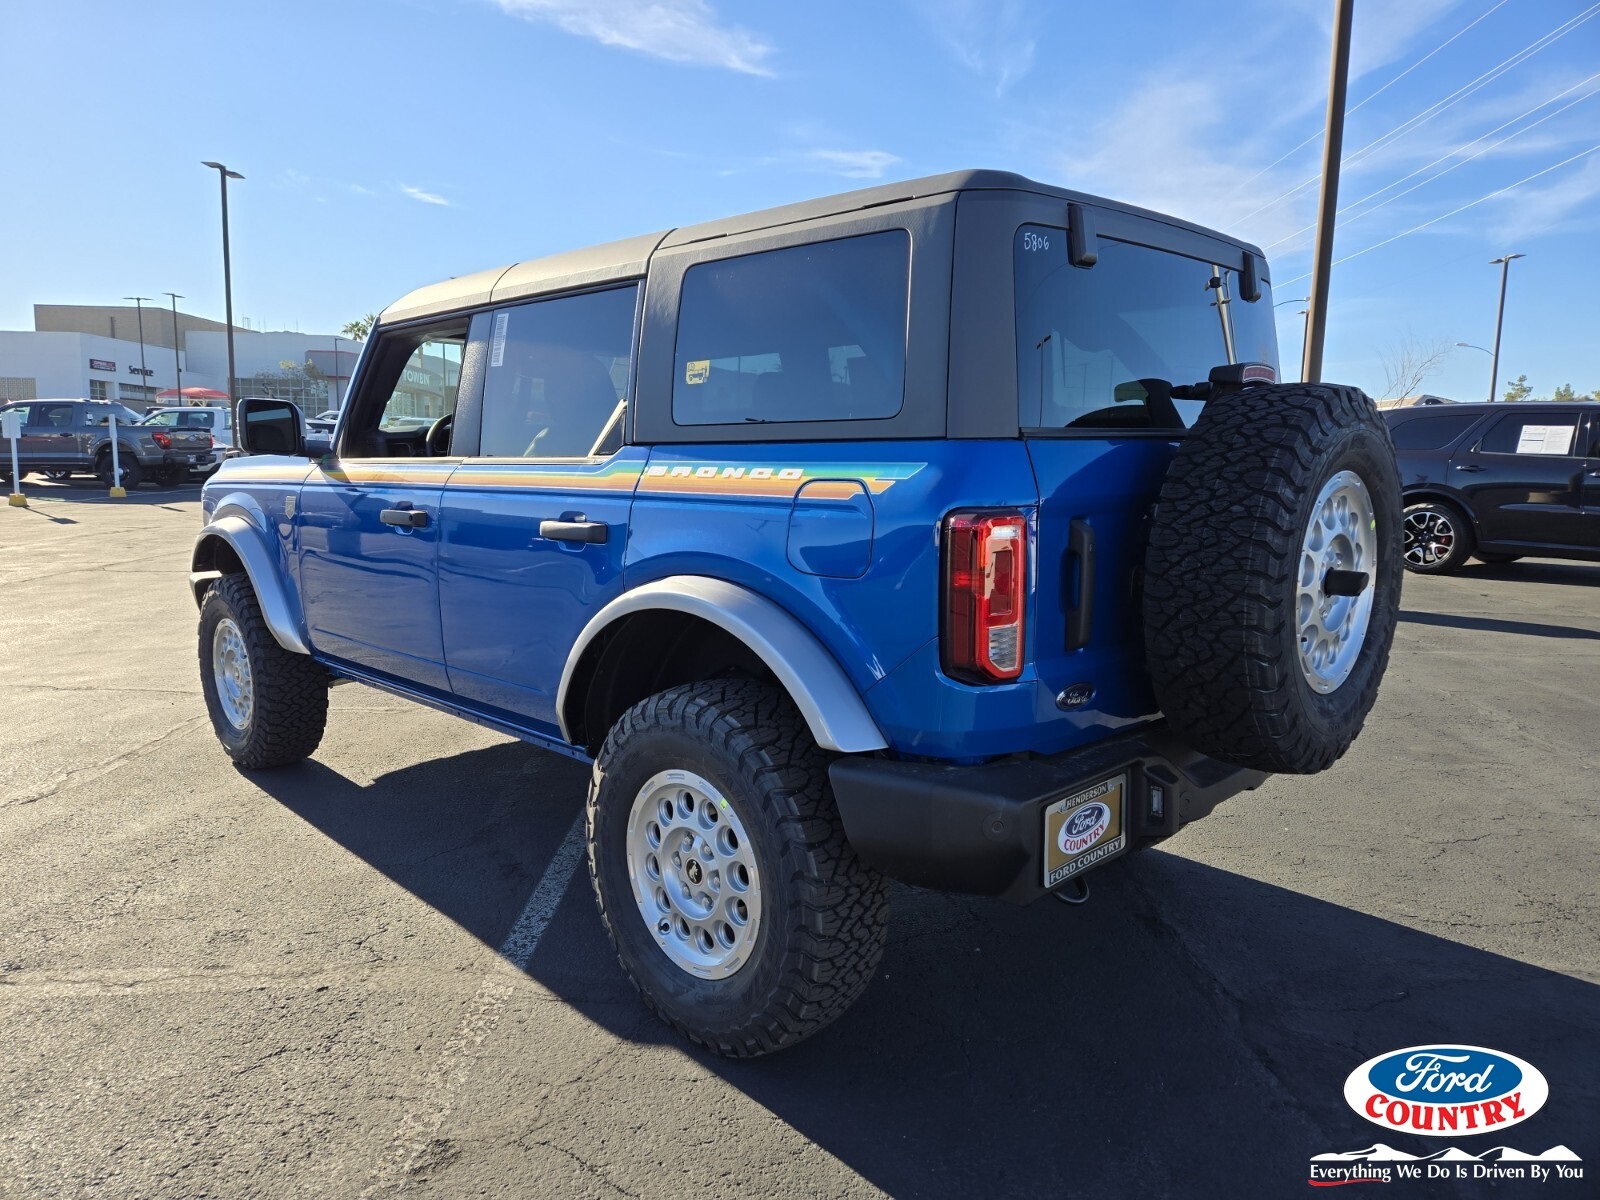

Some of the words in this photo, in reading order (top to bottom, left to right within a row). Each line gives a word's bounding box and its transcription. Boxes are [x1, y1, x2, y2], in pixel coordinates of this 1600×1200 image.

[1024, 232, 1050, 252] 5806
[647, 466, 804, 480] BRONCO
[1066, 784, 1107, 808] HENDERSON
[1072, 809, 1098, 834] Ford
[1064, 822, 1105, 851] COUNTRY
[1050, 864, 1076, 883] FORD
[1077, 840, 1120, 868] COUNTRY
